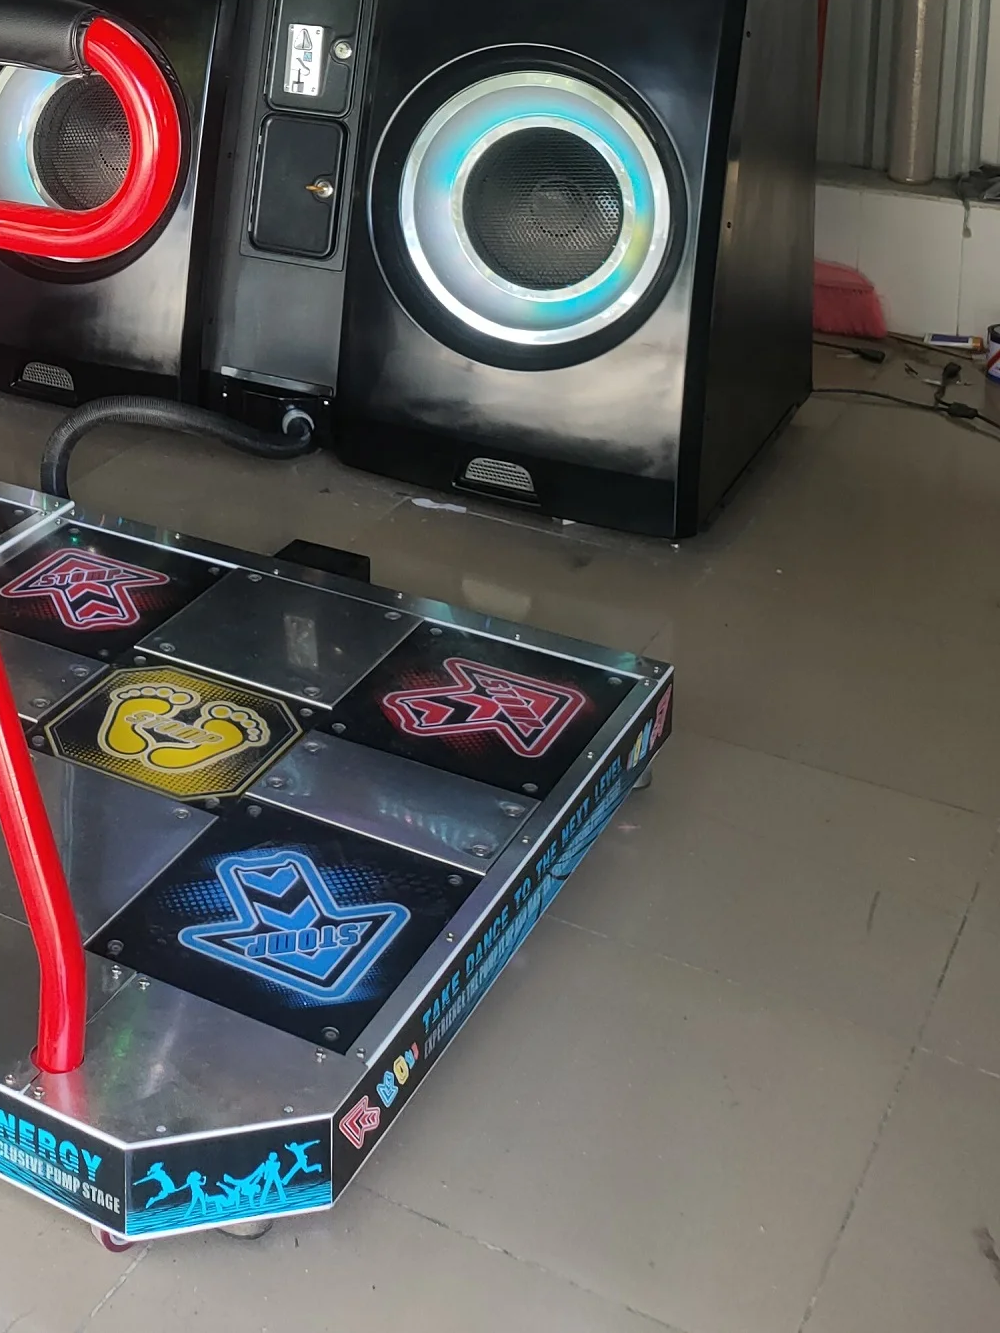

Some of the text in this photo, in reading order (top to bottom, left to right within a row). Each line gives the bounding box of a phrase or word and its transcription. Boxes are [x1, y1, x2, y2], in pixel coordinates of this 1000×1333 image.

[39, 568, 125, 586] STOMP
[244, 923, 361, 959] STOMP
[422, 969, 461, 1034] TAKE
[465, 903, 509, 979] DANCE
[513, 877, 532, 910] TO
[536, 839, 558, 881] THE
[561, 796, 591, 848] NEXT
[424, 988, 465, 1060] EXPERIENCE
[46, 1163, 81, 1194] PUMP
[82, 1181, 121, 1215] STAGE
